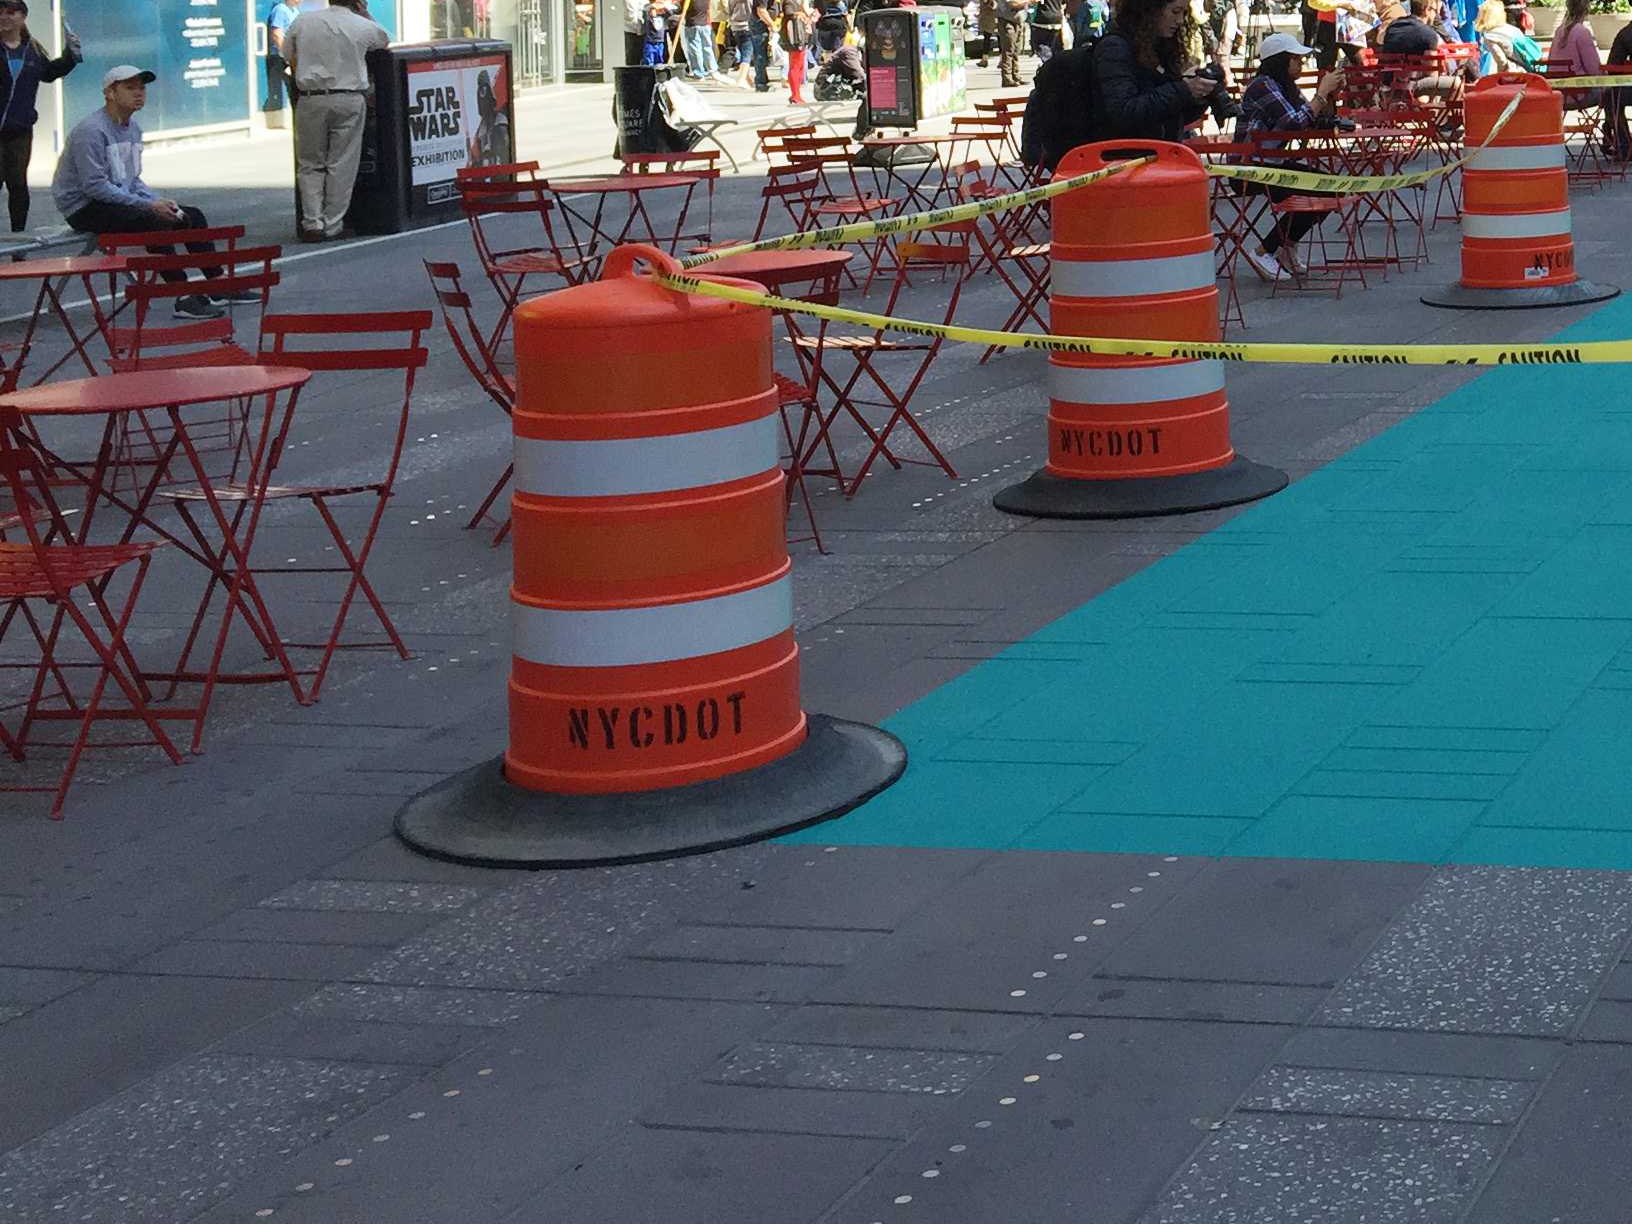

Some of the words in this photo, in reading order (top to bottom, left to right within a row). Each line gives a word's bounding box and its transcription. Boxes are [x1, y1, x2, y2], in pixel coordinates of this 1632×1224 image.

[408, 85, 460, 114] STAR
[408, 111, 461, 141] WARS
[411, 148, 465, 167] EXHIBITION
[1061, 425, 1163, 456] NYCDOT
[568, 690, 746, 750] NYCDOT
